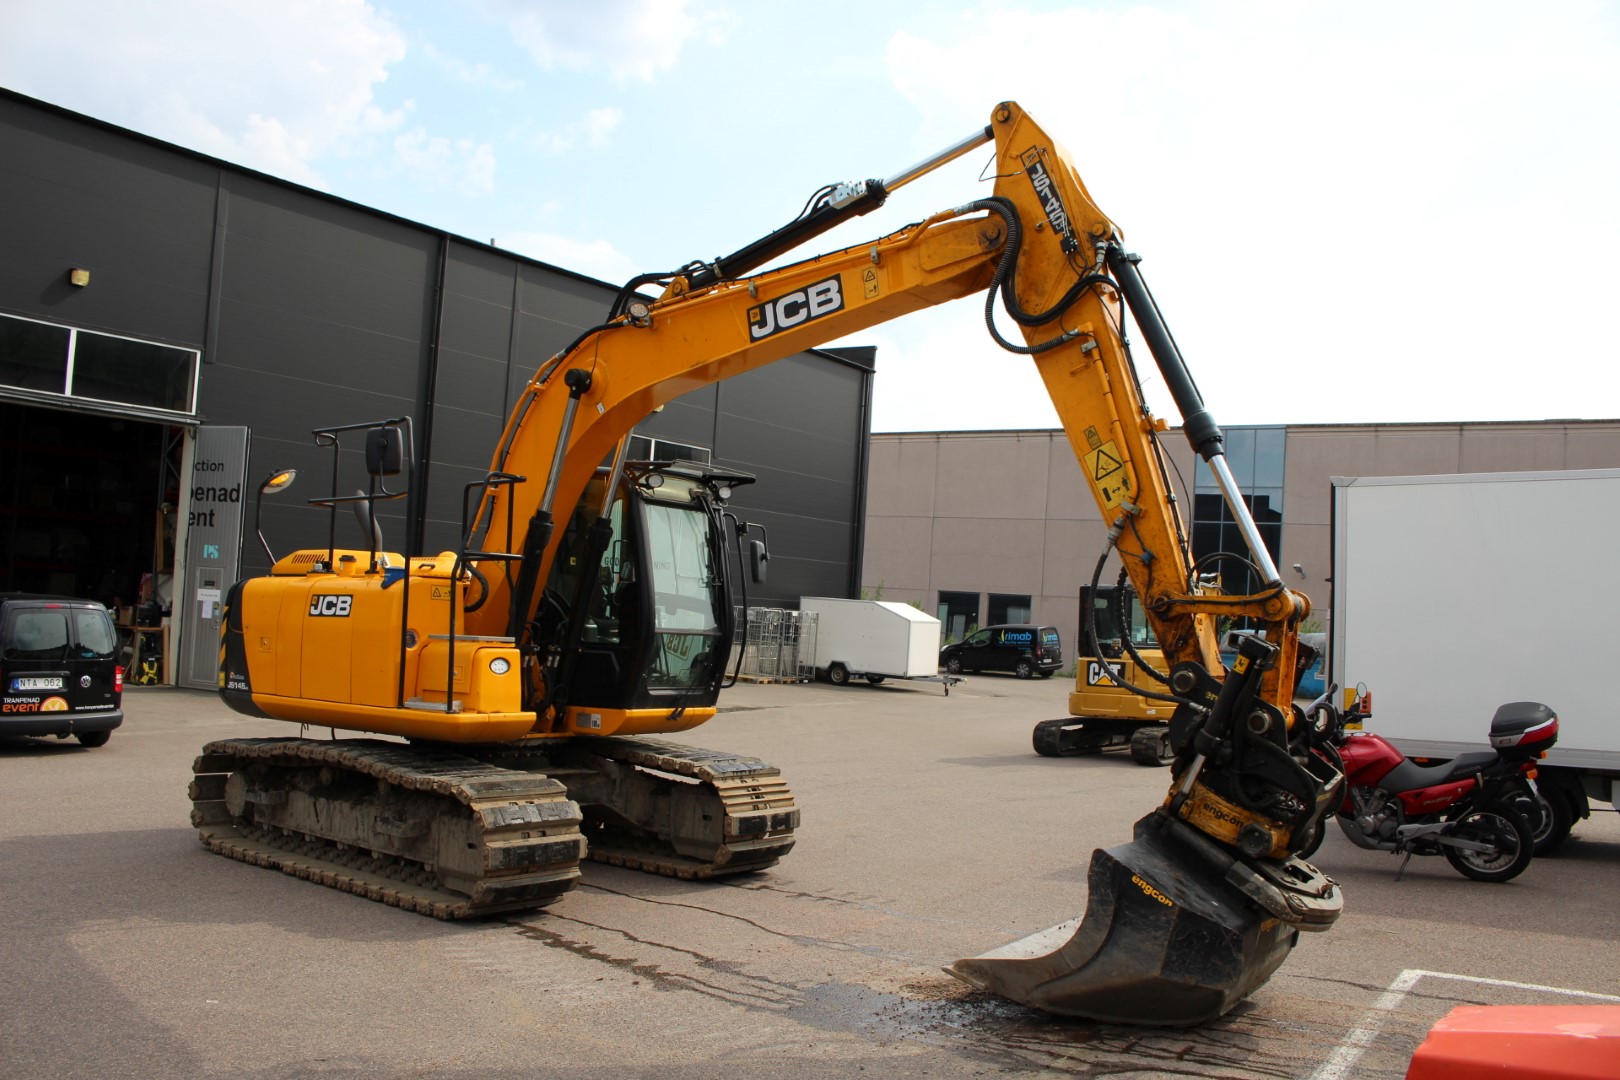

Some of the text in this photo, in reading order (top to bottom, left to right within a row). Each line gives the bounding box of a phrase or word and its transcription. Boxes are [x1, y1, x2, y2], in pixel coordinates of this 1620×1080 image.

[751, 279, 842, 338] JCB
[310, 596, 352, 615] JCB
[1005, 632, 1032, 641] rimab
[20, 678, 61, 687] NTA 062
[2, 703, 40, 712] event
[1203, 802, 1245, 828] engcon
[1131, 874, 1173, 907] engcon
